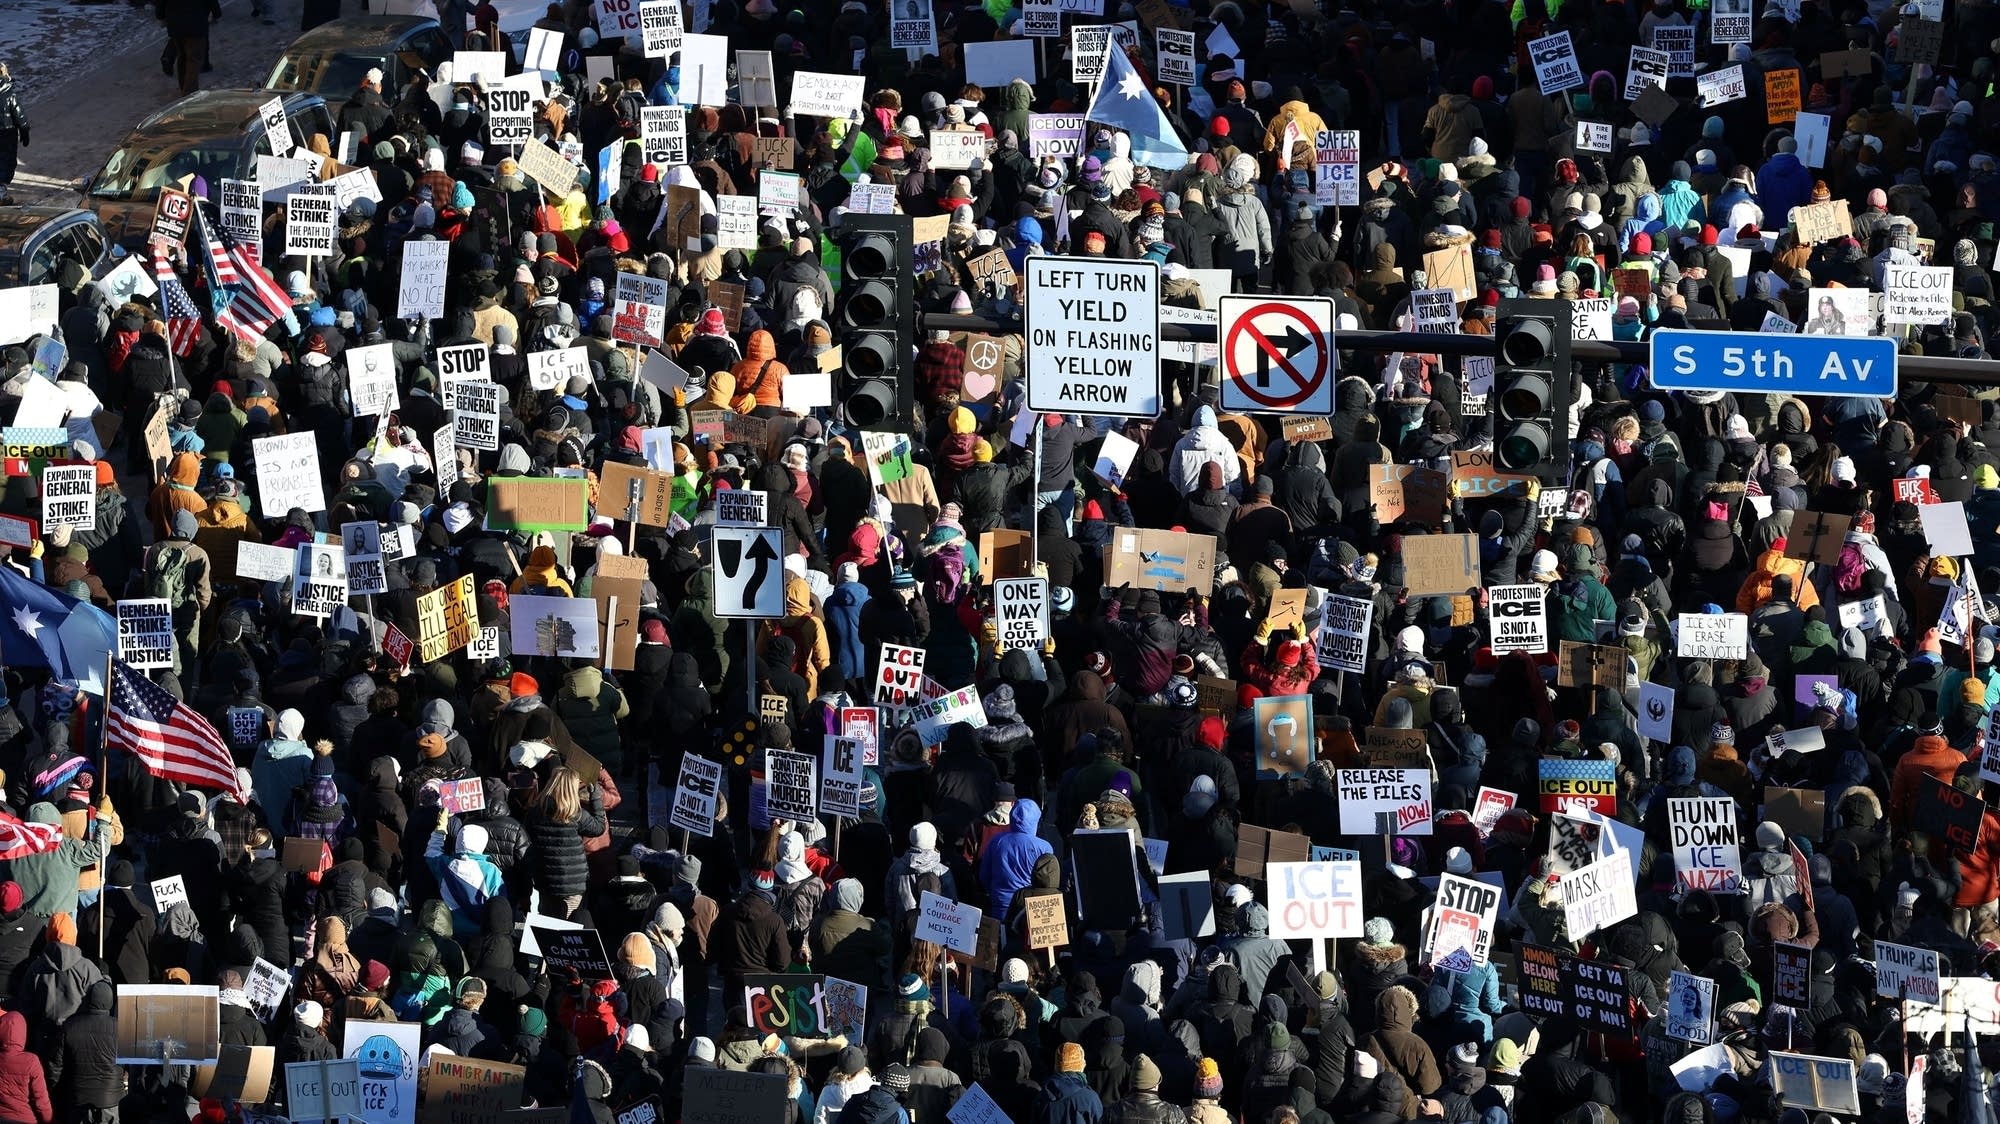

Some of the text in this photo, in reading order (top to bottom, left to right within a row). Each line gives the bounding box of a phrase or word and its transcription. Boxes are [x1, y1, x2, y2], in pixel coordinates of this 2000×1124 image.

[642, 7, 678, 17] GENERAL
[893, 22, 930, 31] JUSTICE FOR
[1714, 16, 1750, 27] JUSTICE FOR
[894, 31, 930, 39] RENEE GOOD
[1158, 31, 1192, 42] PROTESTING
[1656, 29, 1692, 40] GENERAL
[1714, 26, 1750, 35] RENEE GOOD
[1159, 42, 1191, 55] ICE
[1631, 61, 1666, 75] ICE
[798, 76, 860, 90] DEMOCRACY
[491, 91, 529, 111] STOP
[491, 117, 532, 128] DEPORTING
[643, 110, 682, 120] MINNESOTA
[648, 121, 679, 132] STANDS
[1032, 117, 1081, 130] ICE OUT
[492, 128, 531, 137] OUR
[645, 137, 683, 150] AGAINST
[756, 138, 789, 152] FUCK
[936, 136, 983, 146] ICE OUT
[1037, 138, 1079, 153] NOW
[1317, 132, 1356, 149] SAFER
[646, 151, 683, 161] ICE
[1317, 149, 1358, 161] WITHOUT
[1322, 164, 1354, 180] ICE
[223, 194, 260, 209] GENERAL
[291, 199, 332, 211] GENERAL
[225, 213, 256, 228] STRIKE!
[289, 226, 330, 237] THE PATH TO
[288, 237, 329, 249] JUSTICE
[1038, 270, 1146, 291] LEFT TURN
[1891, 270, 1950, 289] ICE OUT
[401, 286, 444, 305] NO ICE
[1414, 293, 1453, 306] MINNESOTA
[1059, 299, 1127, 323] YIELD
[1419, 305, 1450, 318] STANDS
[1034, 329, 1152, 352] ON FLASHING
[442, 348, 484, 374] STOP
[541, 353, 566, 369] ICE
[1054, 356, 1132, 377] YELLOW
[1674, 345, 1873, 381] S 5th Av
[457, 386, 496, 399] EXPAND THE
[1060, 384, 1127, 403] ARROW
[457, 398, 496, 413] GENERAL
[458, 417, 493, 434] STRIKE!
[1297, 423, 1316, 432] NOT
[255, 436, 315, 454] BROWN SKIN
[866, 435, 885, 450] OUT
[5, 447, 67, 457] ICE OUT
[264, 458, 315, 472] IS NOT
[47, 469, 93, 481] EXPAND THE
[47, 480, 92, 495] GENERAL
[264, 476, 317, 491] PROBABLE
[269, 494, 310, 512] CAUSE
[720, 492, 764, 505] EXPAND THE
[48, 501, 89, 516] STRIKE!
[720, 504, 764, 522] GENERAL
[63, 516, 91, 524] OUT!
[348, 559, 380, 578] JUSTICE
[297, 582, 344, 599] JUSTICE
[1003, 583, 1040, 600] ONE
[1491, 588, 1541, 601] PROTESTING
[119, 604, 168, 618] GENERAL
[1003, 603, 1042, 620] WAY
[1326, 604, 1367, 622] JONATHAN
[1493, 602, 1541, 617] ICE
[120, 619, 171, 633] STRIKE:
[1008, 622, 1034, 630] ICE
[1500, 622, 1537, 634] IS NOT A
[1685, 617, 1707, 628] ICE
[120, 633, 171, 647] THE PATH TO
[1004, 630, 1037, 640] OUT
[1323, 633, 1363, 652] MURDER
[1494, 635, 1543, 643] CRIME!
[1695, 631, 1726, 642] ERASE
[1003, 639, 1040, 648] NOW
[121, 647, 171, 663] JUSTICE
[884, 646, 924, 666] ICE
[1682, 644, 1743, 659] OUR VOICE
[883, 667, 920, 688] OUT
[878, 685, 920, 707] NOW
[761, 698, 782, 712] ICE
[913, 687, 977, 721] HISTORY
[834, 739, 854, 773] ICE
[683, 755, 719, 779] PROTESTING
[679, 774, 715, 794] ICE
[824, 778, 858, 791] OUT OF
[1343, 770, 1405, 785] RELEASE
[1341, 785, 1422, 800] THE FILES
[1540, 781, 1569, 793] ICE
[823, 786, 857, 806] MINNESOTA
[1672, 800, 1730, 825] HUNT
[1675, 825, 1735, 846] DOWN
[1691, 847, 1725, 868] ICE
[1284, 865, 1353, 899] ICE
[1564, 868, 1598, 903] MASK
[1678, 869, 1739, 891] NAZIS
[1029, 899, 1060, 910] ABOLISH
[1441, 879, 1496, 915] STOP
[926, 908, 962, 924] COURAGE
[1033, 908, 1054, 918] ICE
[1284, 900, 1355, 931] OUT
[928, 923, 953, 934] MELTS
[1031, 922, 1065, 935] PROTECT
[945, 937, 959, 946] ICE
[546, 956, 607, 971] BREATHE
[1578, 965, 1623, 986] GET YA
[1671, 973, 1711, 993] JUSTICE
[1531, 977, 1557, 994] HERE
[1575, 984, 1622, 1007] ICE OUT
[745, 981, 828, 1034] resist
[1523, 994, 1564, 1014] ICE OUT
[1669, 1021, 1707, 1041] GOOD
[296, 1080, 356, 1097] ICE OUT
[363, 1083, 387, 1097] FCK
[365, 1097, 385, 1109] ICE
